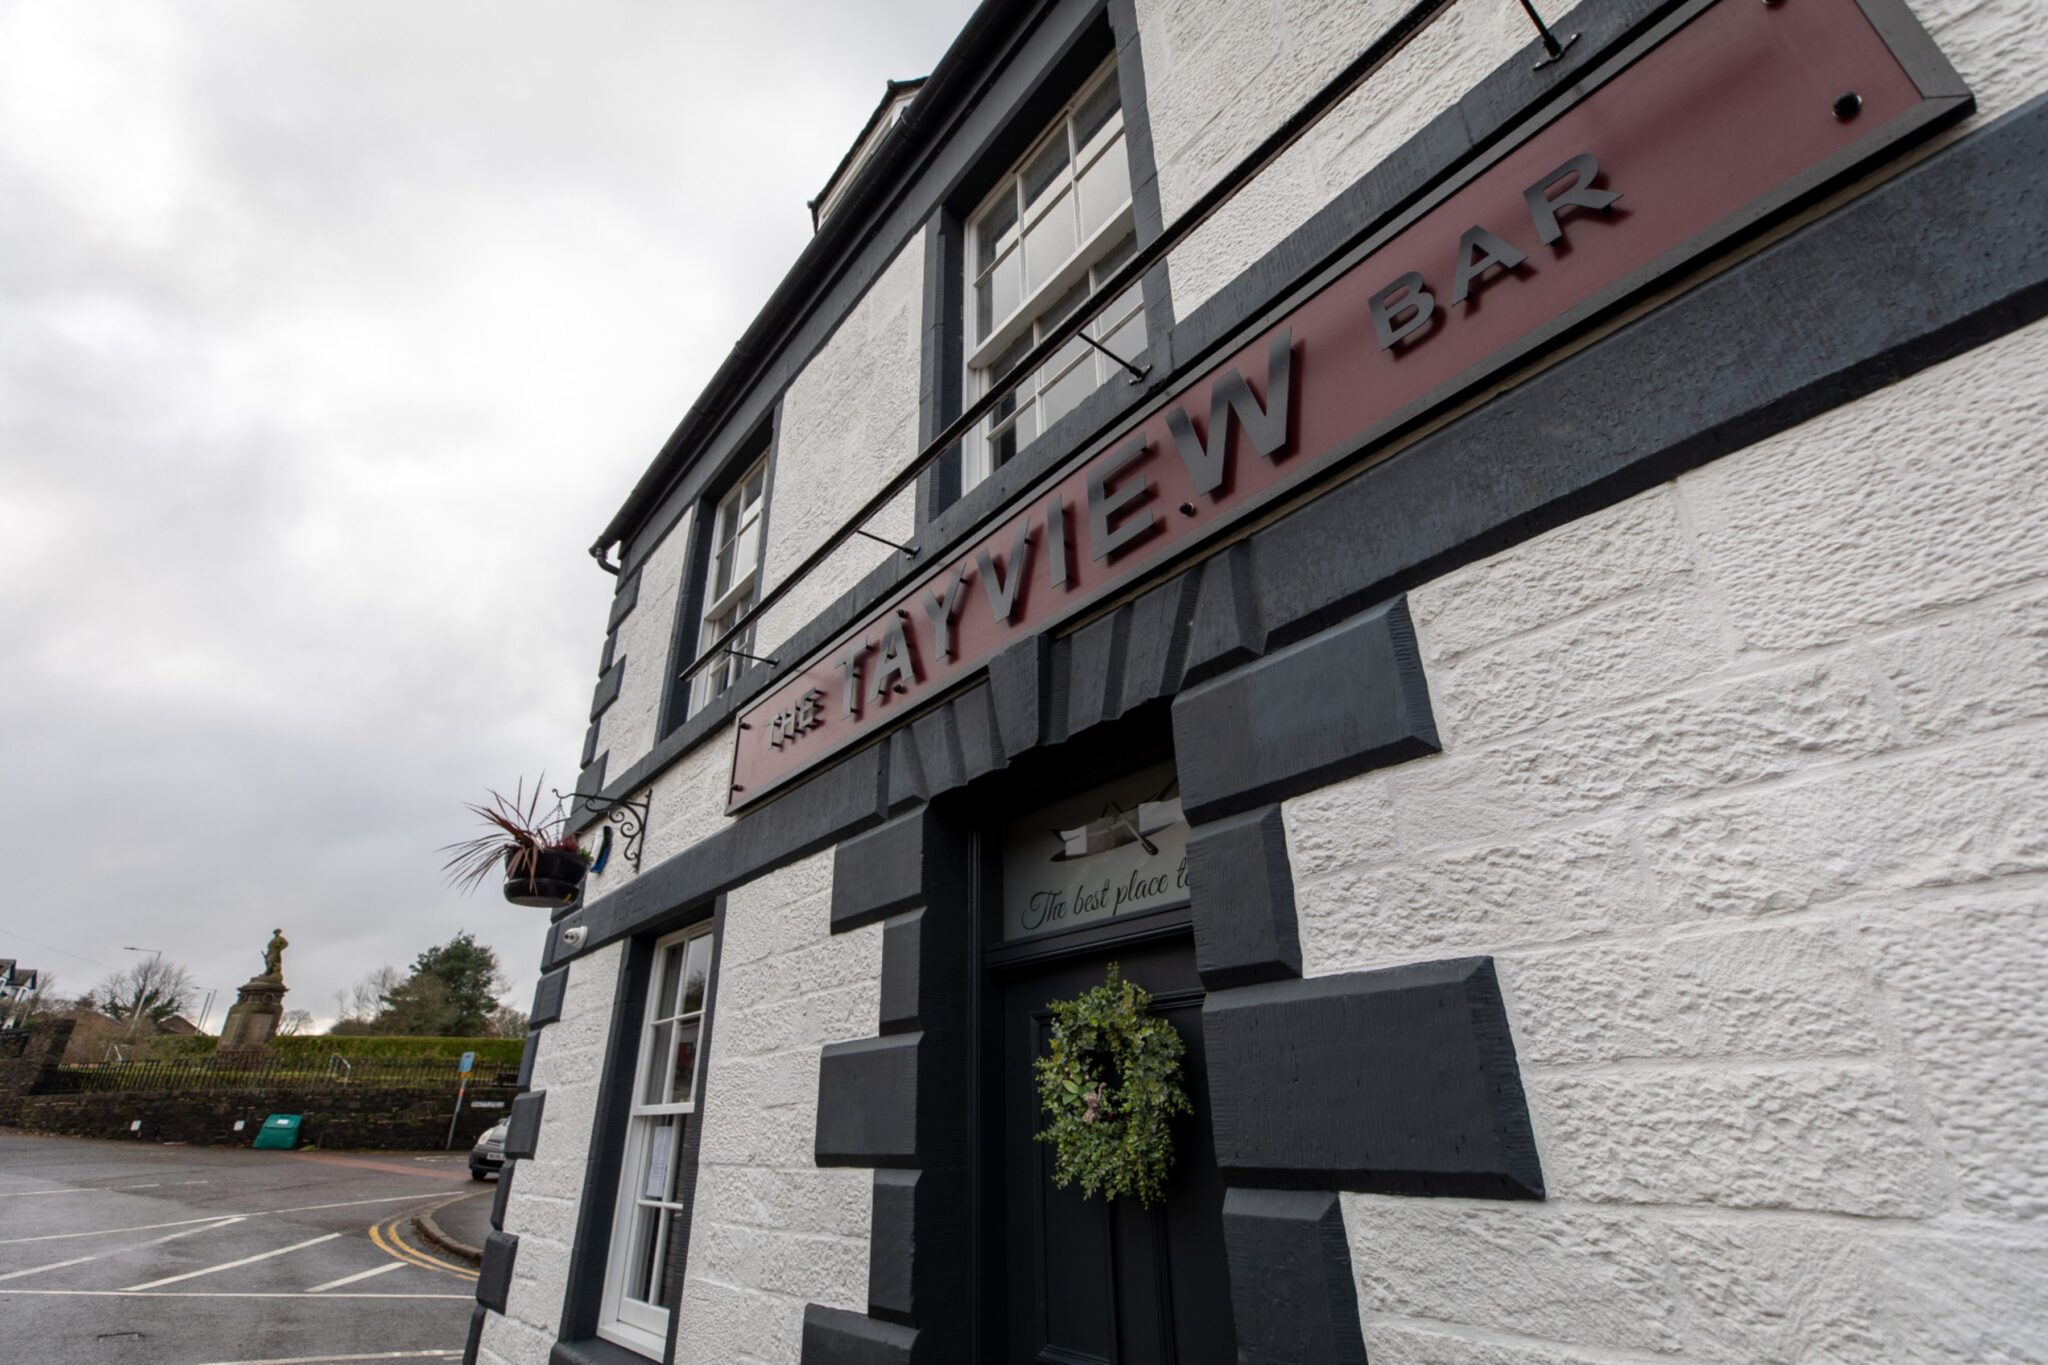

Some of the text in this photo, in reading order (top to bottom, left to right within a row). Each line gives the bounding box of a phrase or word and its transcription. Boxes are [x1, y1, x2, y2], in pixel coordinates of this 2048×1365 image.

[767, 152, 1625, 751] THE TAYVIEW BAR
[1020, 889, 1067, 931] The
[1073, 878, 1110, 916] best
[1112, 869, 1169, 917] place
